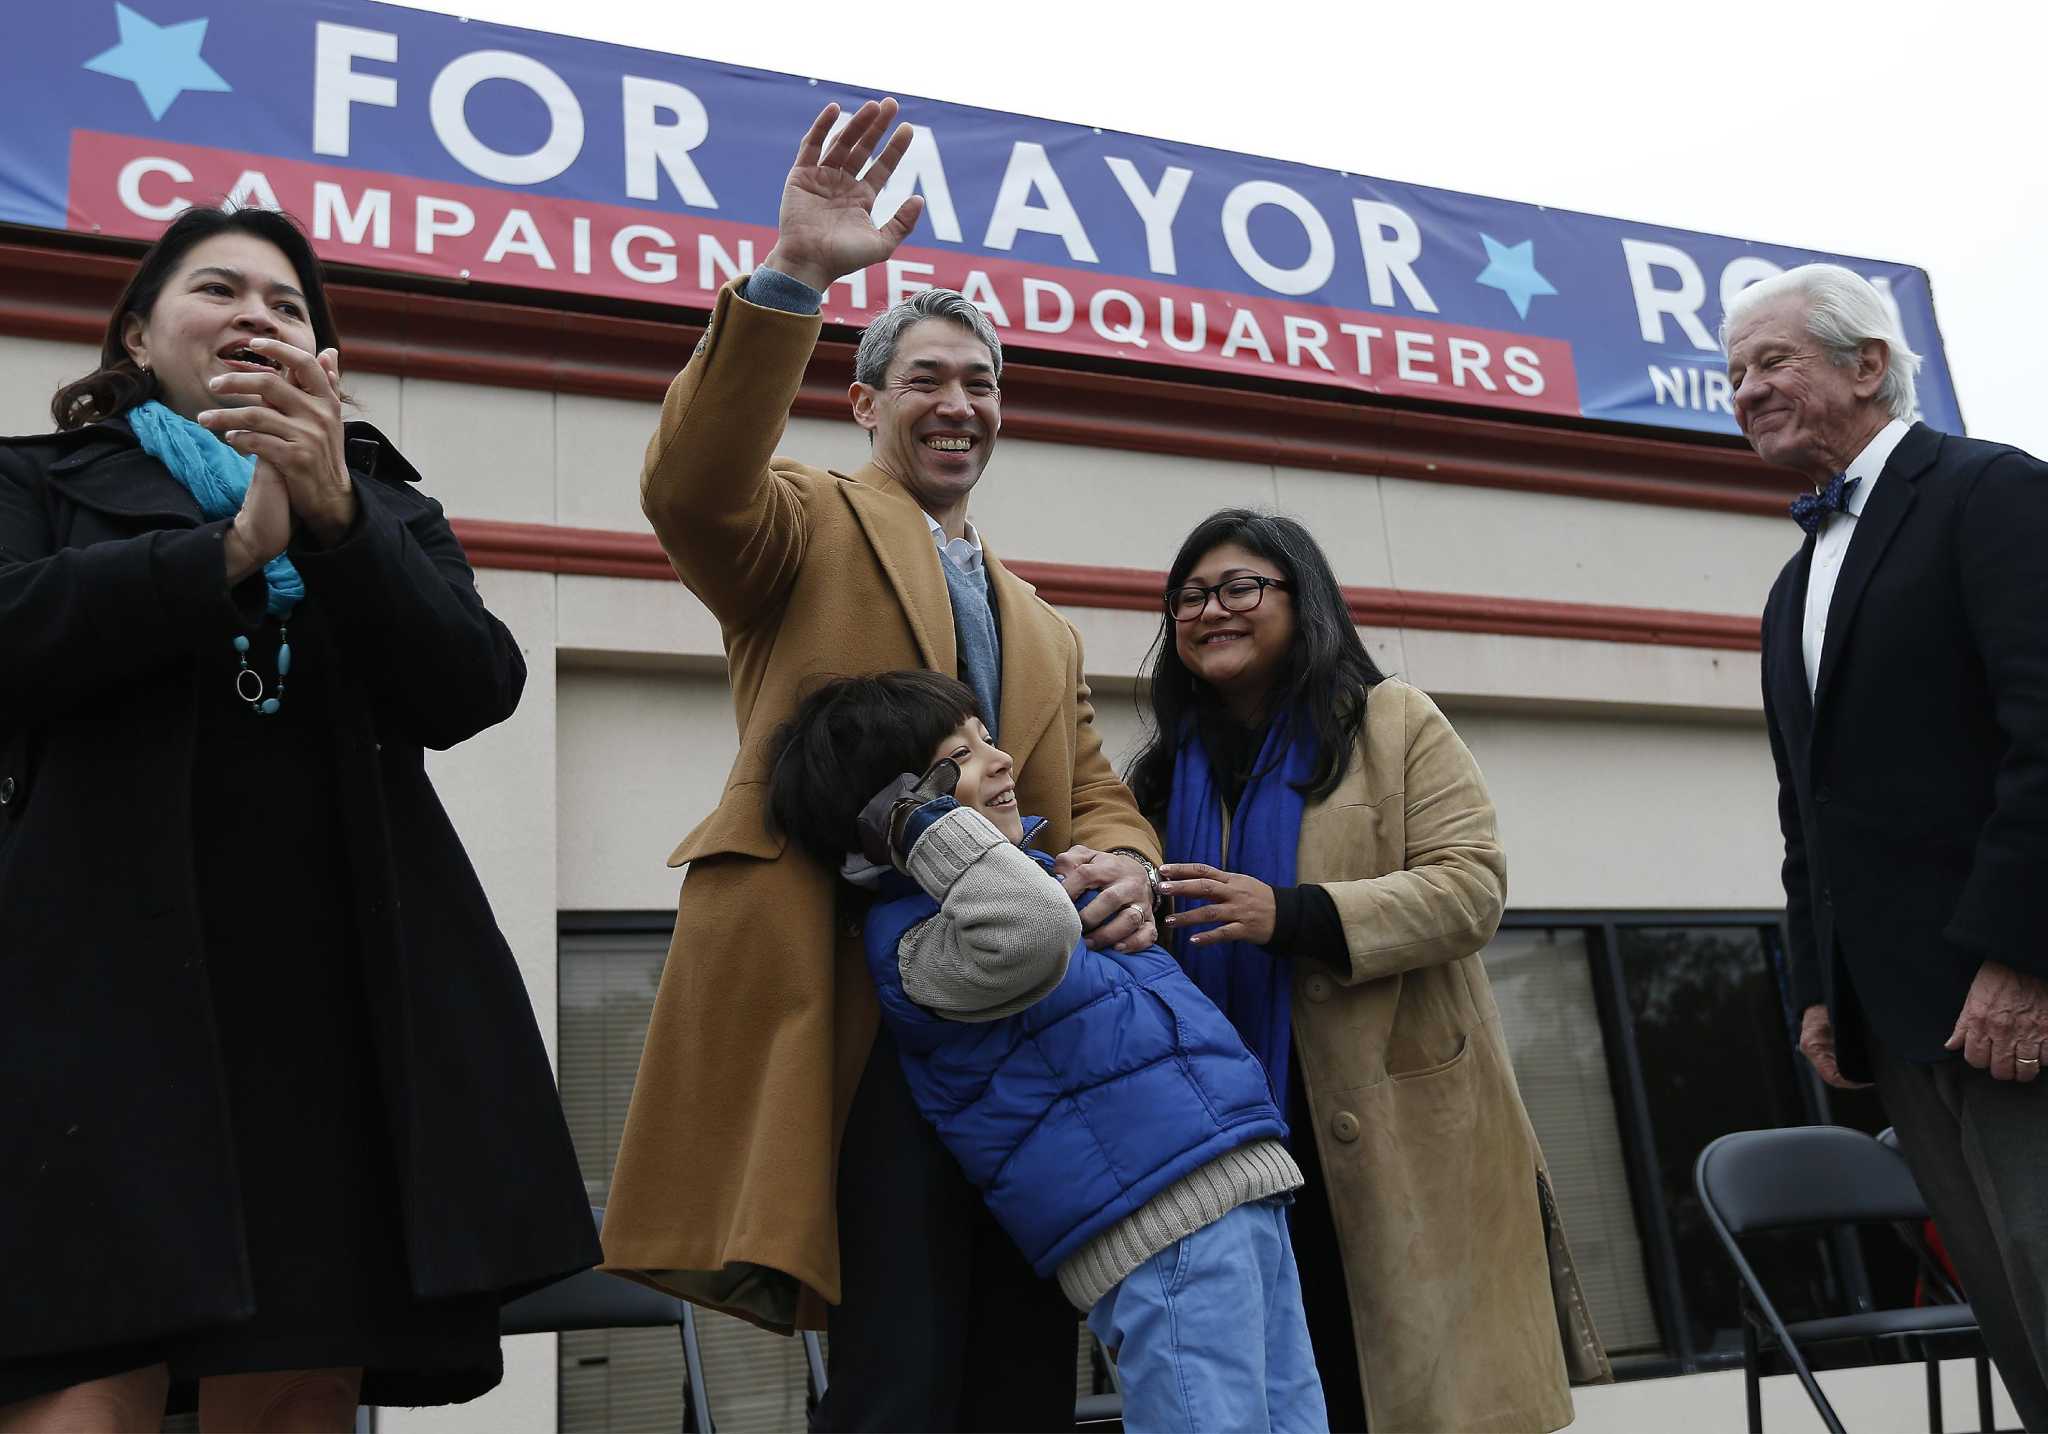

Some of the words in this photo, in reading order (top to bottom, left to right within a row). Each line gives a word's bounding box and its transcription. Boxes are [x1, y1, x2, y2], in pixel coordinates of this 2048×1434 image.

[117, 156, 755, 291] CAMPAIGN
[311, 20, 719, 210] FOR
[819, 109, 1440, 314] MAYOR
